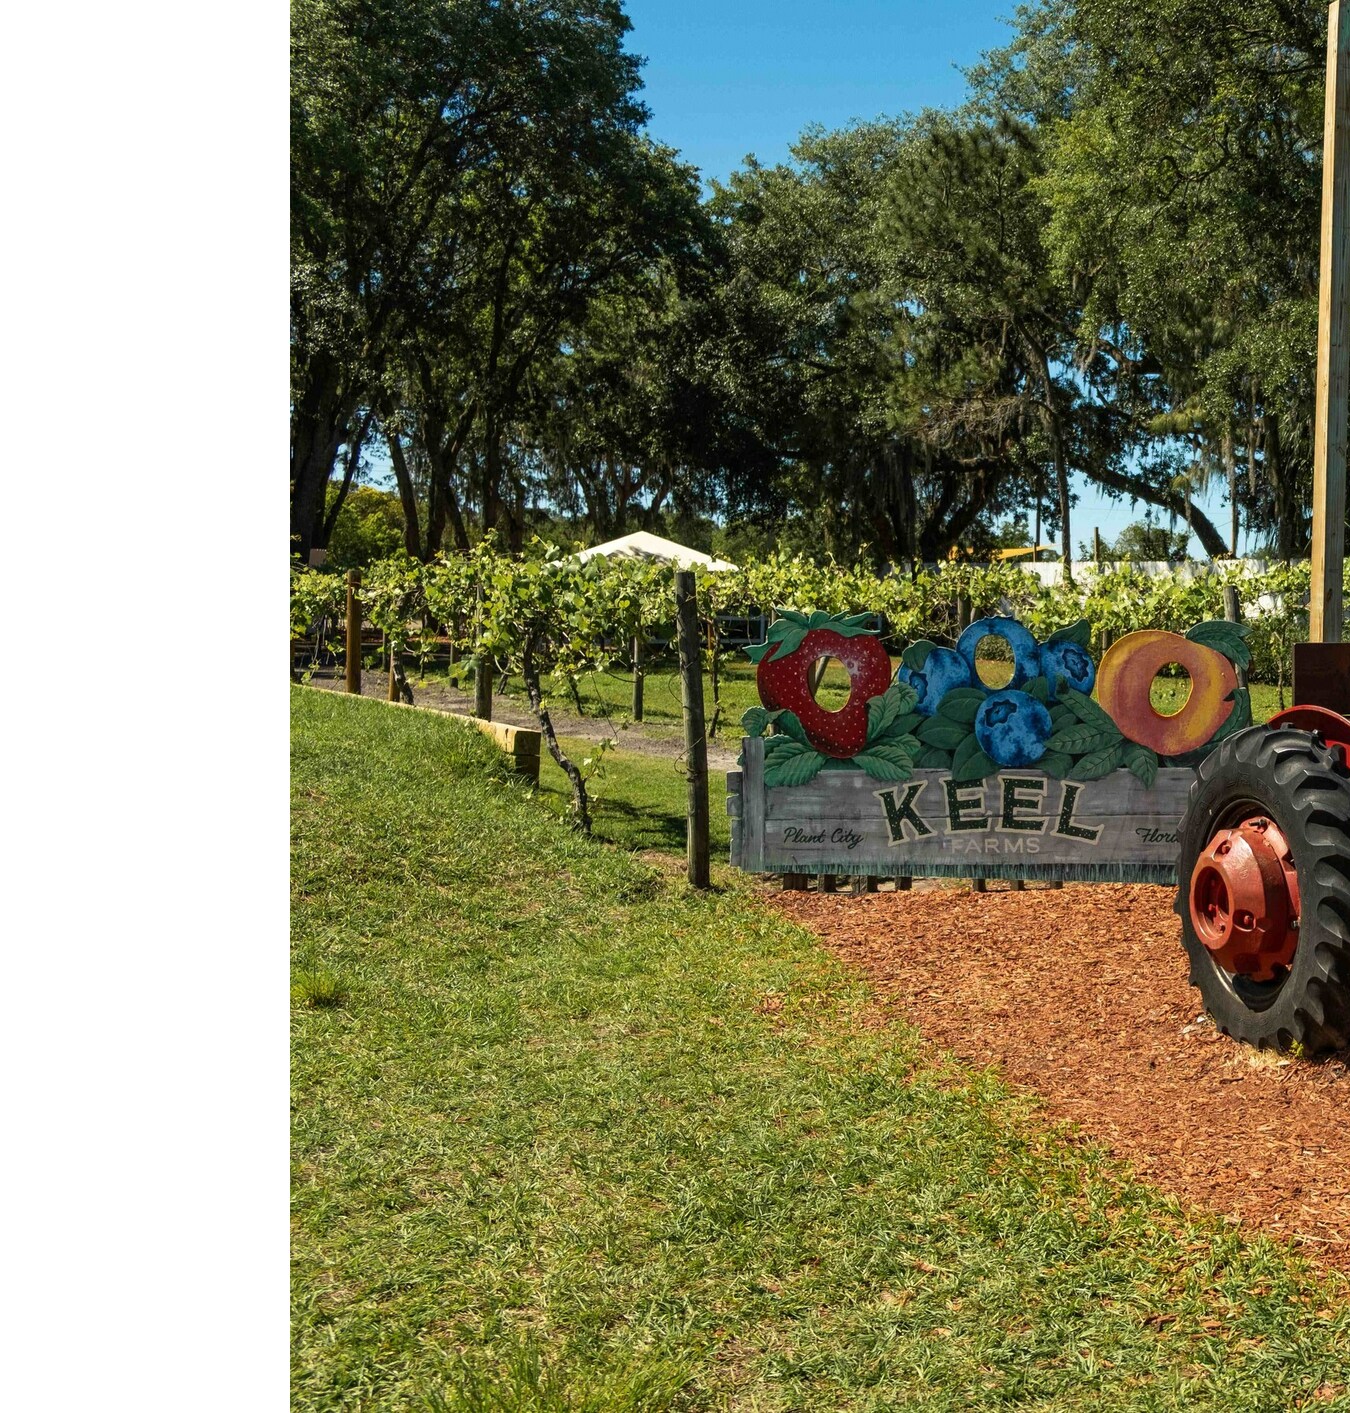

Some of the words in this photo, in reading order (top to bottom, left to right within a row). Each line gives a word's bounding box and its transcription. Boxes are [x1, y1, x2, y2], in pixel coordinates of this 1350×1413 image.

[873, 774, 1105, 847] KEEL
[783, 826, 826, 844] Plant
[830, 827, 865, 850] City
[951, 837, 1041, 854] FARMS
